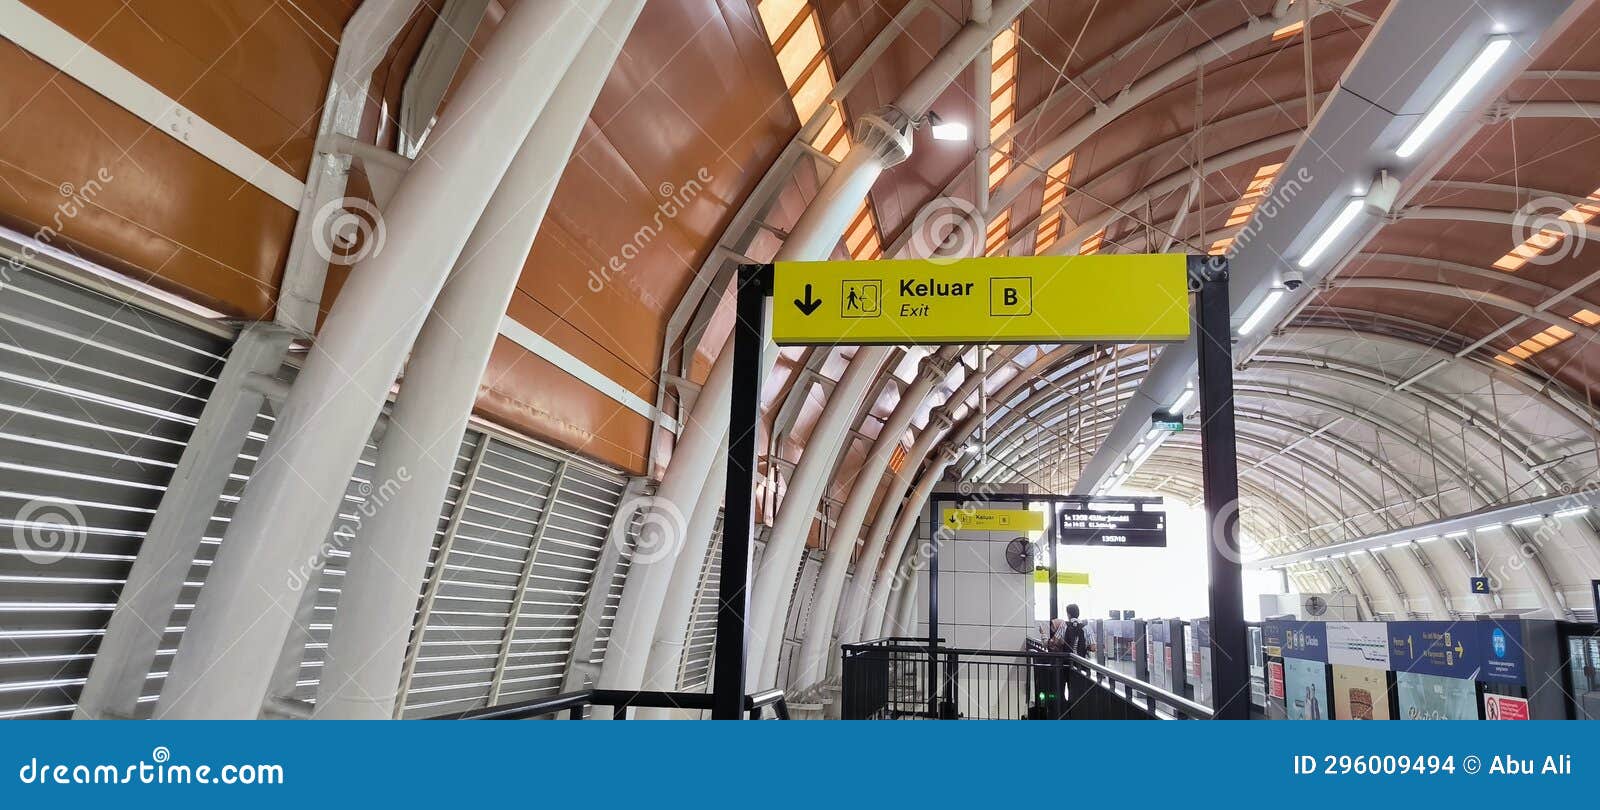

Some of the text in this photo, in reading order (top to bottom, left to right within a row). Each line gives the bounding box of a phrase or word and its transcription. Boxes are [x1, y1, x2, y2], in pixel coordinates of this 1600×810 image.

[899, 278, 974, 298] Keluar
[1003, 287, 1018, 306] B
[899, 303, 930, 318] Exit
[1476, 581, 1485, 591] 2
